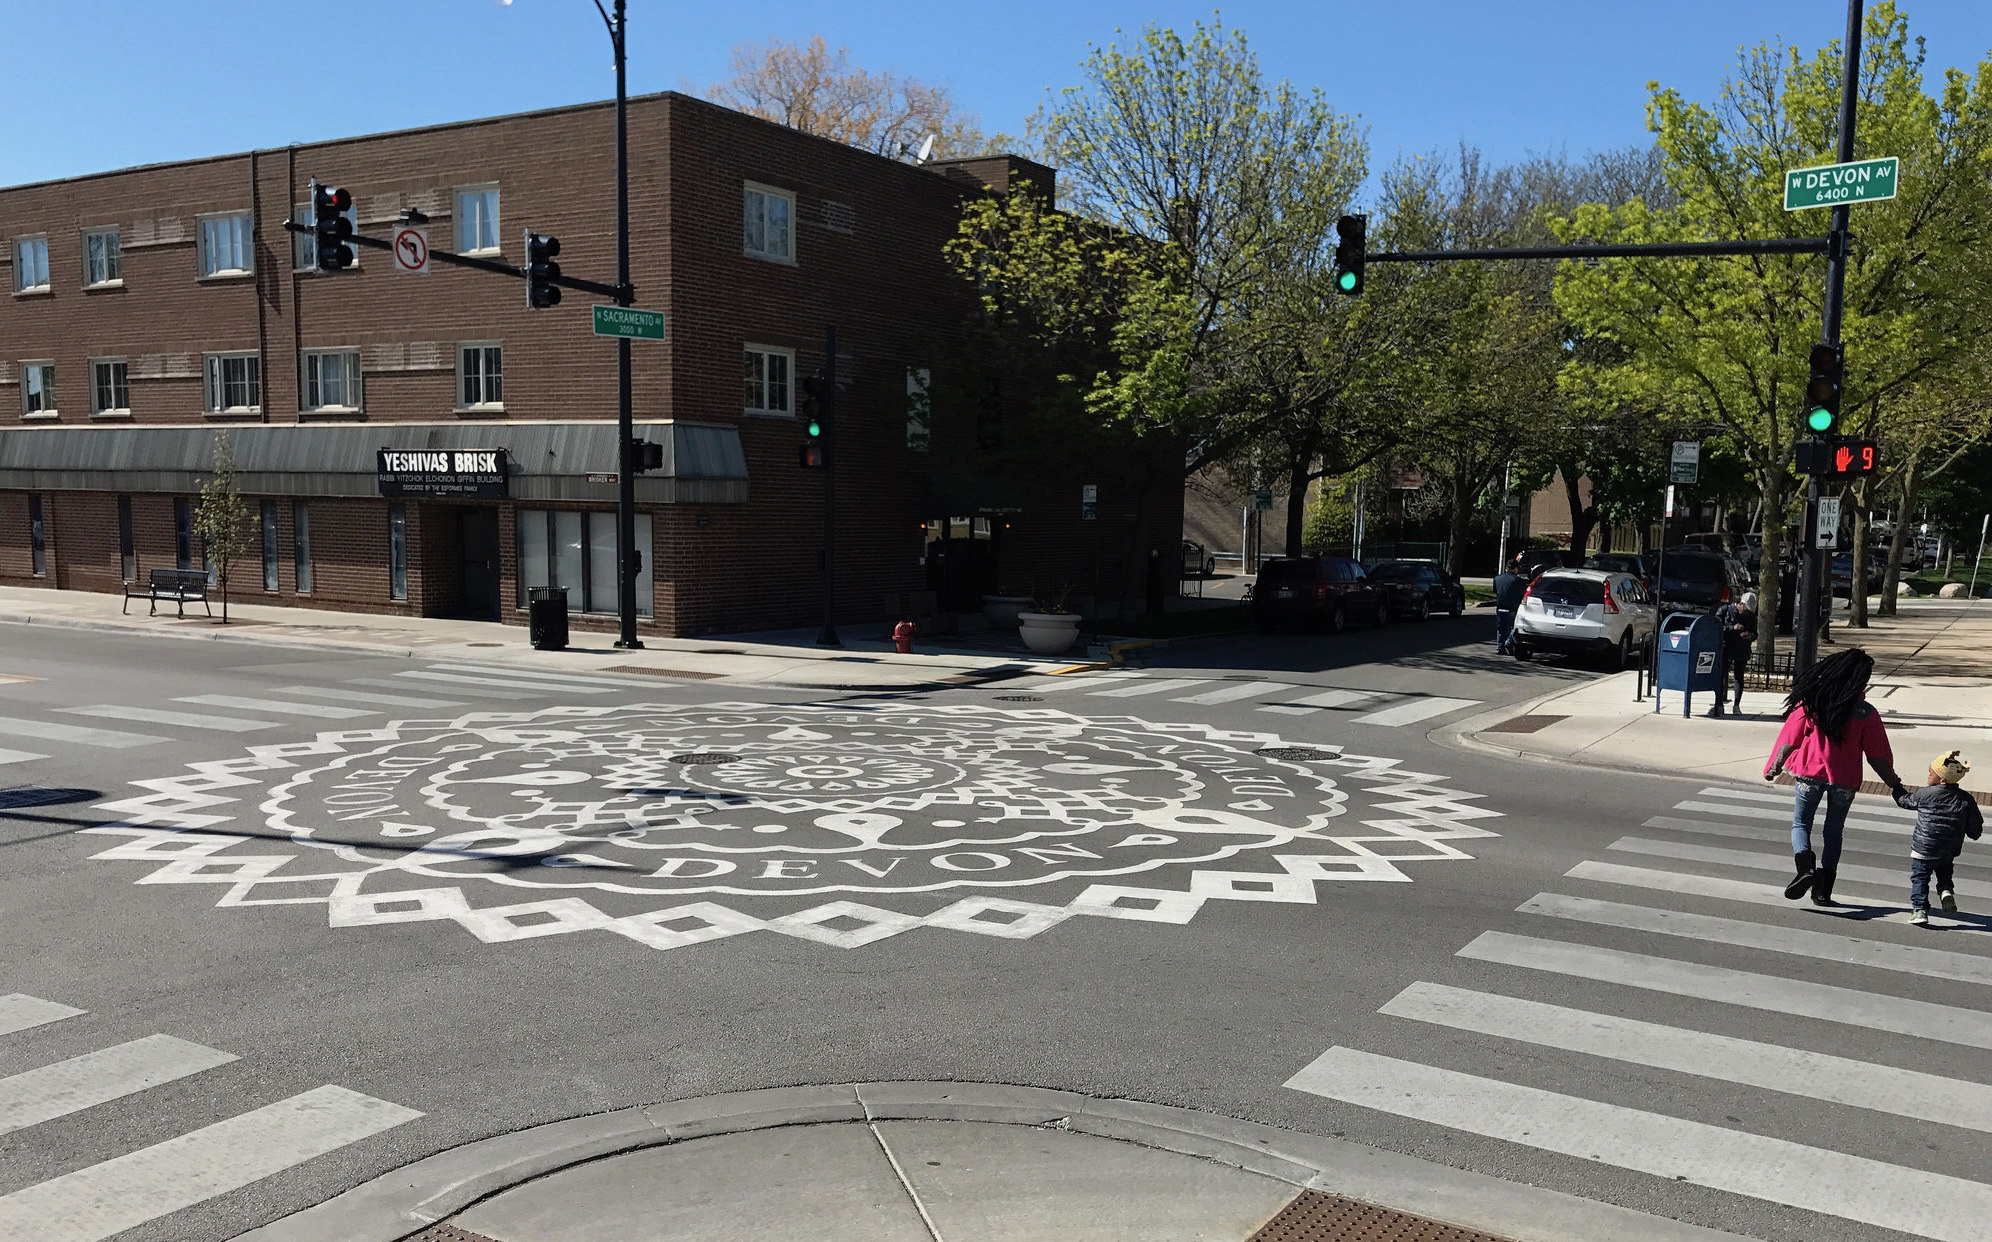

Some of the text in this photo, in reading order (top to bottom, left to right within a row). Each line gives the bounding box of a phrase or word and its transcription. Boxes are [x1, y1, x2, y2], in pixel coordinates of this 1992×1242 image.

[1792, 165, 1892, 189] W DEVON AV
[1815, 185, 1865, 202] 6400 N
[597, 311, 602, 319] N
[603, 310, 654, 327] SACRAMENTO
[383, 452, 498, 473] YESHIVAS BRISK
[1862, 446, 1874, 470] 9
[379, 474, 395, 482] RABBI
[397, 474, 424, 482] YITZCHOK
[477, 475, 504, 484] BUILDING
[1821, 502, 1837, 514] ONE
[1820, 515, 1836, 528] WAY
[1134, 743, 1296, 799] DEVON
[322, 755, 446, 822] DEVON
[639, 842, 1105, 879] DEVON
